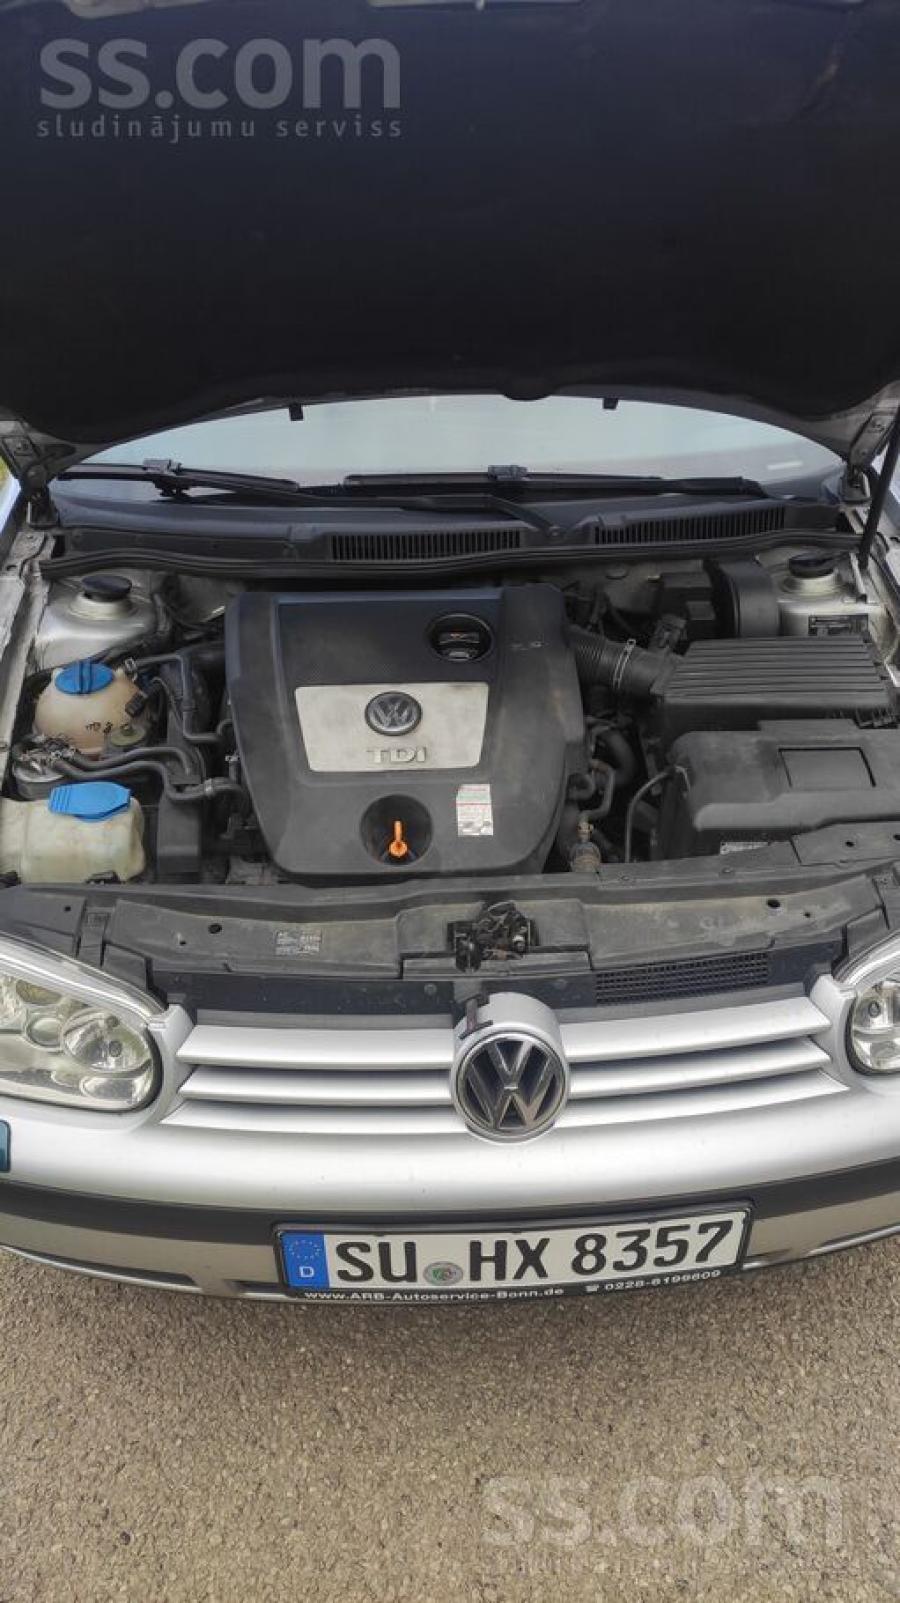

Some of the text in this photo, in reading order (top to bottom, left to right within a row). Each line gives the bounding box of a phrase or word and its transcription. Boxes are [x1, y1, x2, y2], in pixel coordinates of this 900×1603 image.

[367, 746, 427, 764] TDI
[336, 1220, 734, 1283] SU HX 8357
